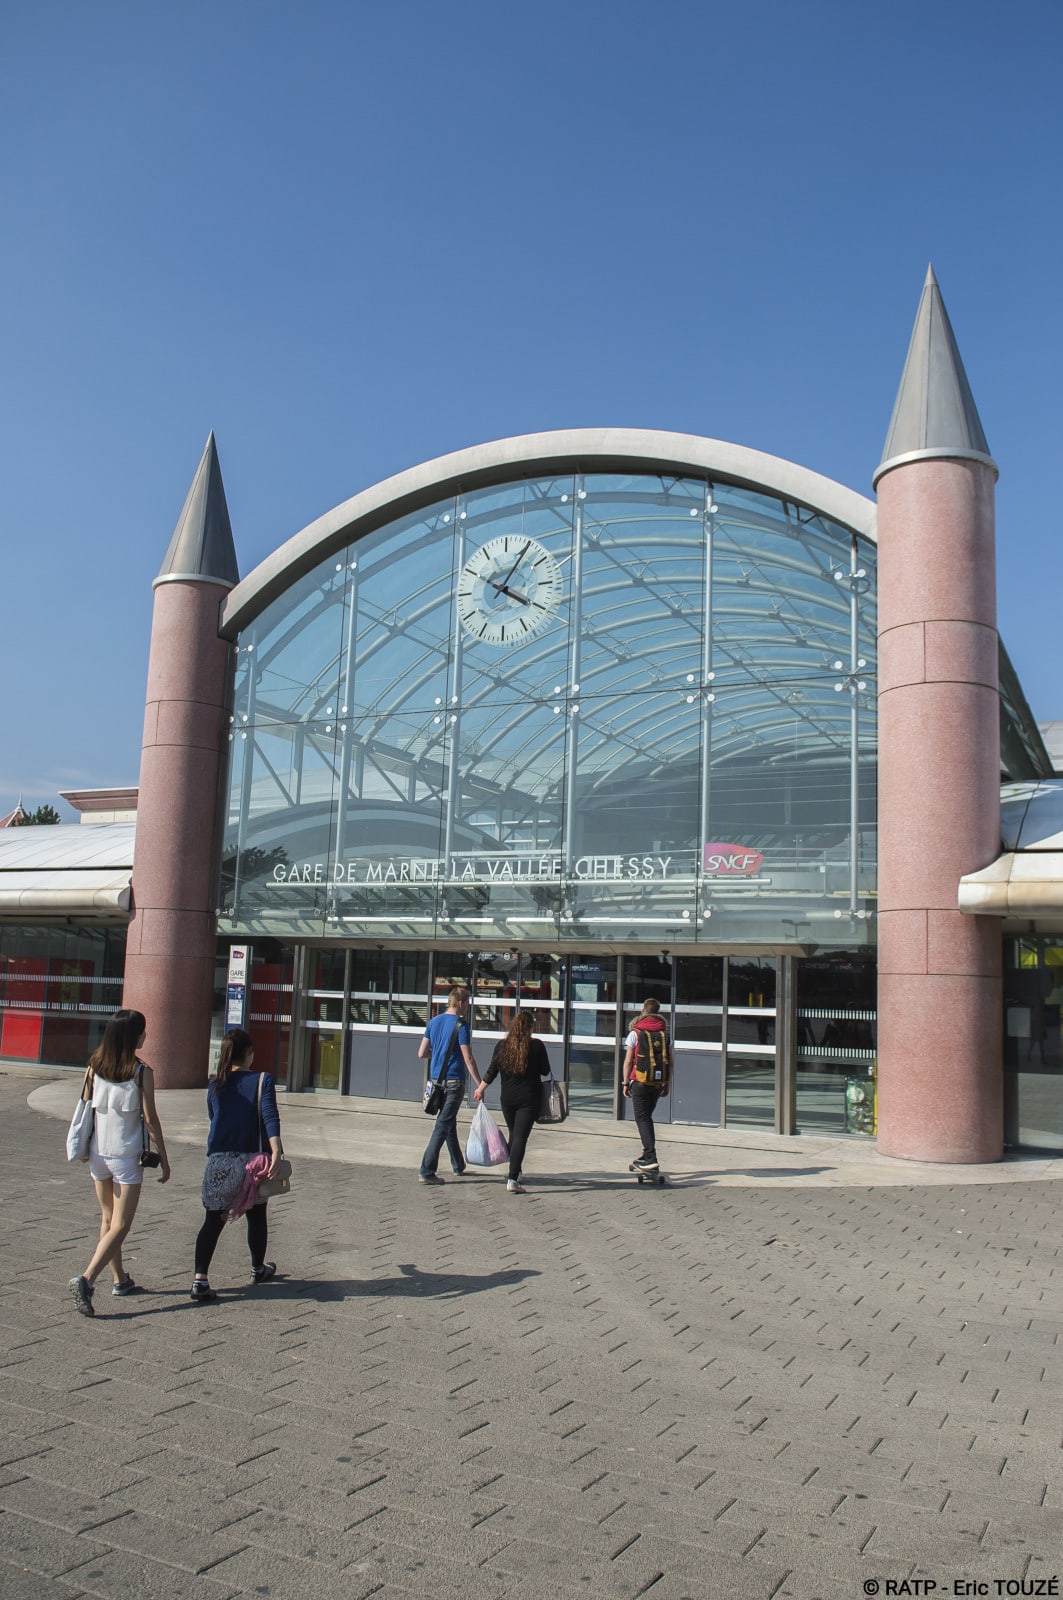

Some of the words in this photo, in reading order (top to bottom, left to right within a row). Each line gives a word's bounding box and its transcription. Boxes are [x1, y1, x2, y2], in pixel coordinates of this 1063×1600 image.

[273, 863, 324, 880] GARE
[333, 863, 357, 880] DE
[366, 862, 441, 881] MARNE
[451, 861, 476, 881] LA
[487, 854, 561, 880] VALLÉE
[575, 857, 672, 877] CHESSY
[706, 854, 758, 871] SNCF
